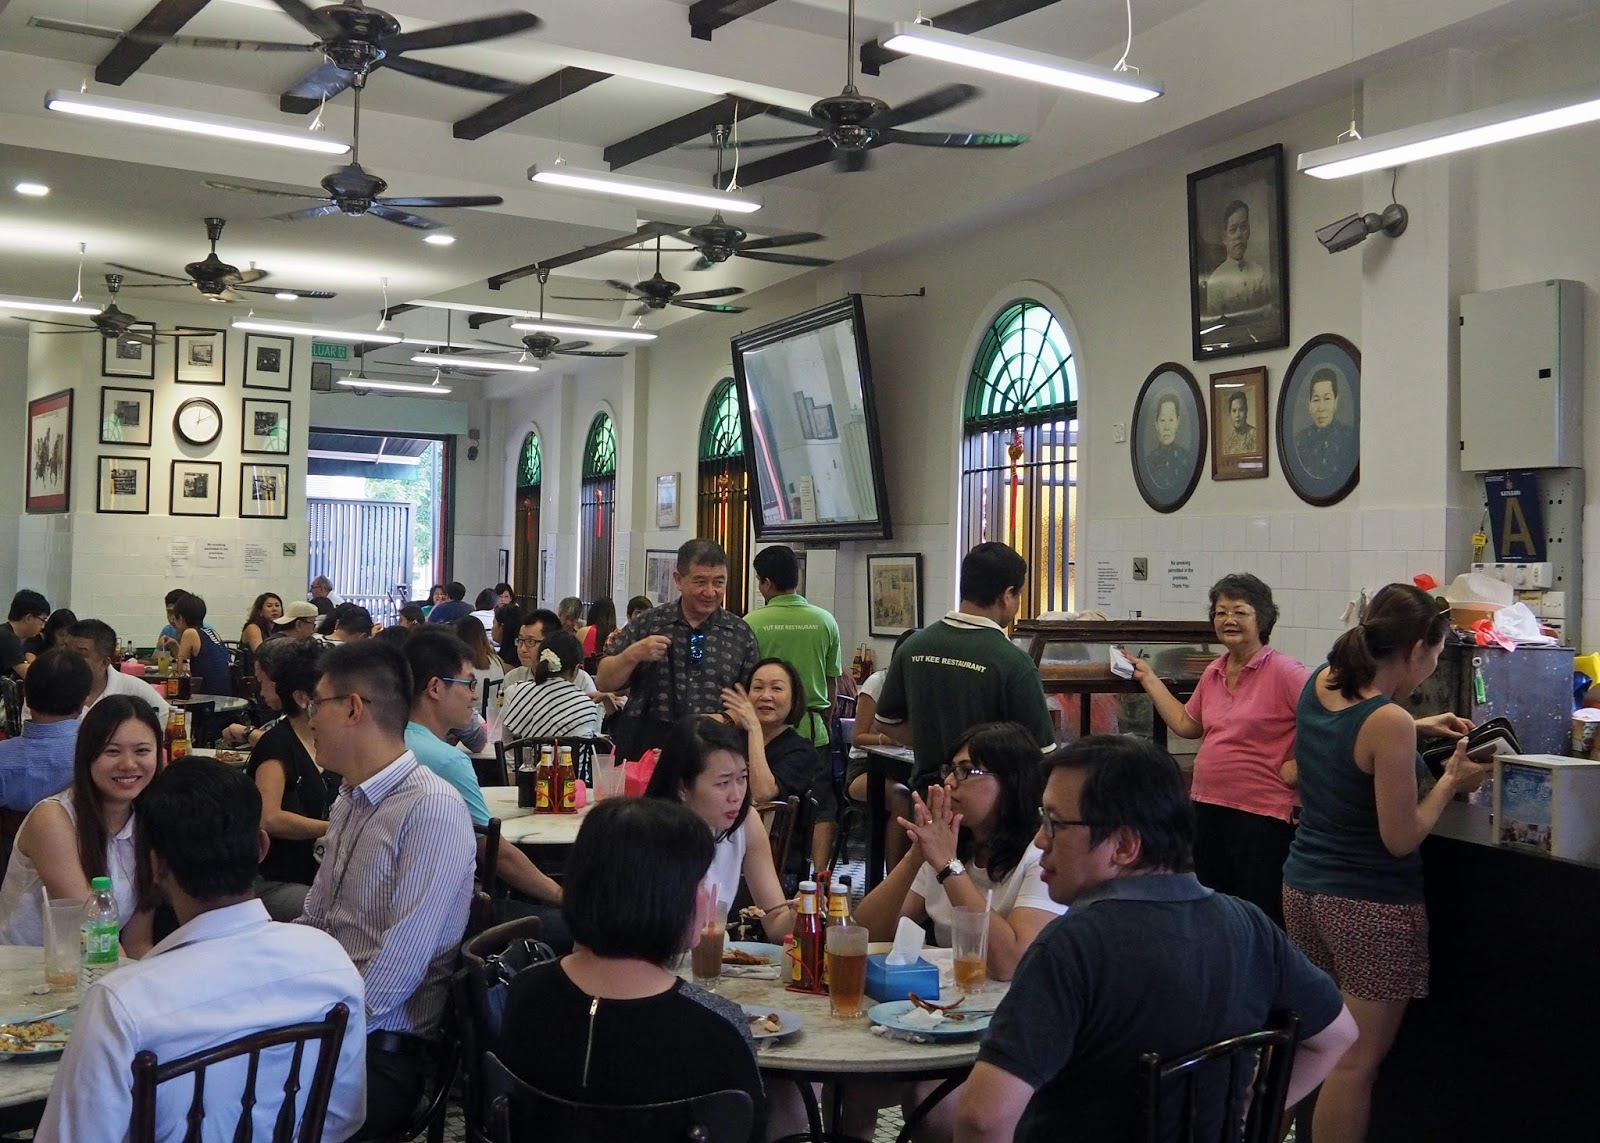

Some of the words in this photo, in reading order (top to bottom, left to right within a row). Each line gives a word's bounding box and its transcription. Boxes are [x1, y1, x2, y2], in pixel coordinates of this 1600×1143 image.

[1501, 497, 1537, 556] A
[911, 655, 924, 663] YUT
[925, 655, 940, 663] KEE
[941, 657, 987, 673] RESTAURANT
